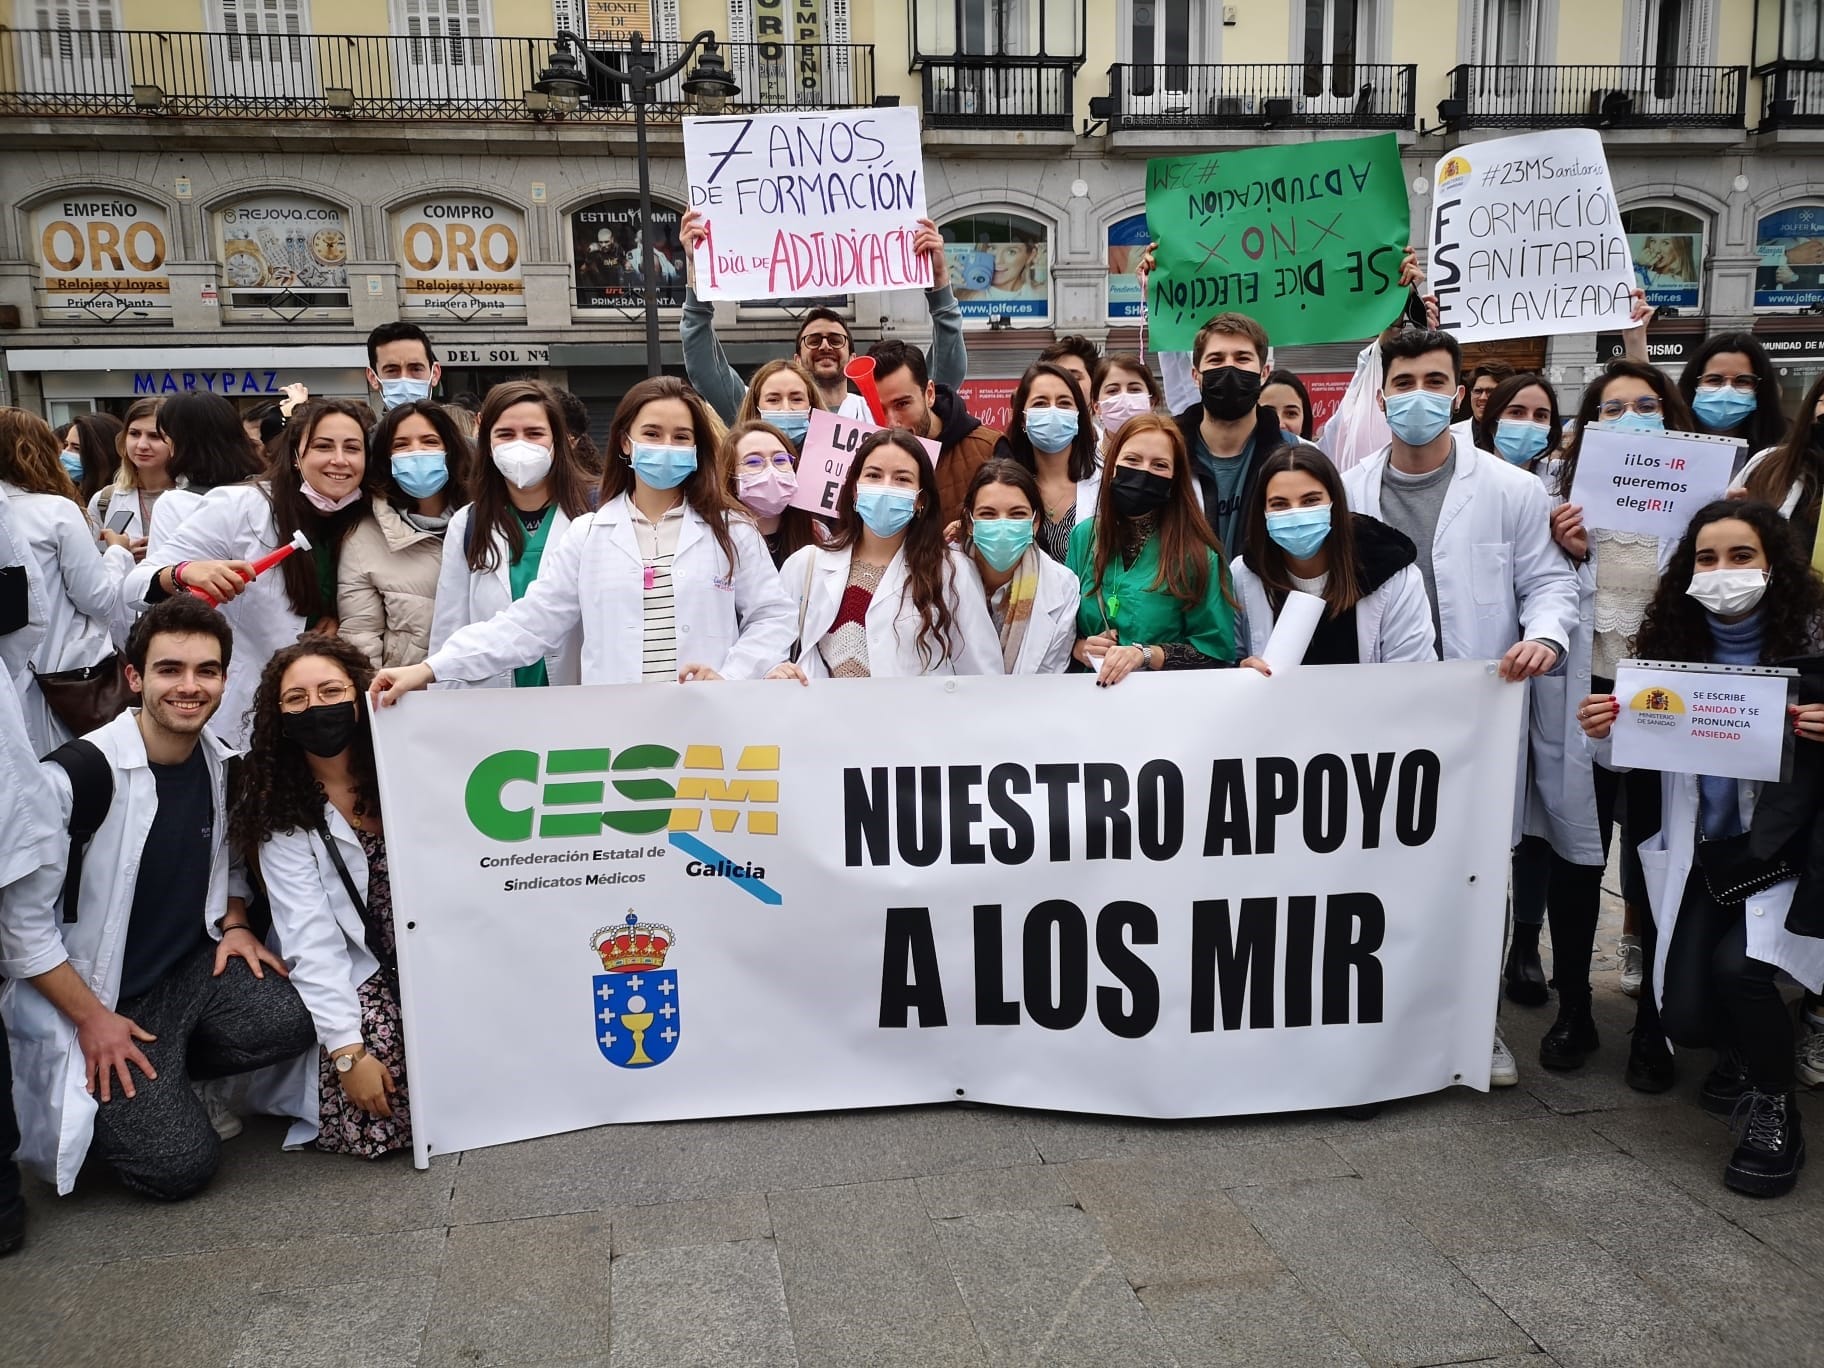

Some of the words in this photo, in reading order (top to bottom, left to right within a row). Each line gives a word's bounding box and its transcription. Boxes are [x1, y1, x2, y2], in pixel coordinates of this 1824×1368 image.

[693, 119, 753, 184] 7
[769, 116, 885, 168] AÑOS
[691, 185, 723, 206] DE
[736, 160, 916, 216] FORMACIÓN
[64, 200, 137, 217] EMPEÑO
[423, 205, 494, 219] COMPRO
[580, 212, 628, 222] ESTILO
[42, 221, 166, 272] ORO
[403, 222, 519, 272] ORO
[752, 256, 770, 269] DE
[1346, 246, 1393, 295] SE
[58, 278, 109, 293] Relojes
[110, 281, 121, 293] y
[125, 278, 162, 293] Joyas
[417, 279, 464, 293] Relojes
[480, 280, 514, 294] Joyas
[67, 298, 114, 308] Primera
[116, 298, 153, 308] Planta
[425, 299, 467, 308] Primera
[470, 299, 505, 308] Planta
[591, 297, 636, 306] PRIMERA
[1768, 293, 1824, 304] www.jolfer.
[1646, 344, 1683, 355] RISMO
[1762, 341, 1801, 350] MUNIDAD
[1805, 341, 1817, 349] DE
[447, 350, 480, 361] DEL
[489, 350, 519, 361] SOL
[134, 371, 279, 393] MARYPAZ
[1612, 475, 1688, 493] queremos
[1616, 496, 1674, 513] elegIR!!
[1693, 691, 1704, 700] SE
[1707, 692, 1746, 702] ESCRIBE
[1638, 712, 1675, 720] MINISTERIO
[1692, 704, 1737, 715] SANIDAD
[1739, 707, 1746, 715] Y
[1748, 707, 1760, 716] SE
[1647, 719, 1676, 727] SANIDAD
[1691, 717, 1751, 729] PRONUNCIA
[1691, 729, 1741, 741] ANSIEDAD
[465, 743, 780, 843] CESM
[843, 758, 1184, 868] NUESTRO
[1202, 748, 1441, 857] APOYO
[480, 850, 590, 868] Confederación
[592, 847, 644, 862] Estatal
[646, 846, 666, 859] de
[685, 860, 766, 880] Galicia
[504, 875, 582, 891] Sindicatos
[585, 871, 646, 886] Médicos
[878, 906, 948, 1028] A
[973, 899, 1160, 1039] LOS
[1190, 891, 1386, 1033] MIR
